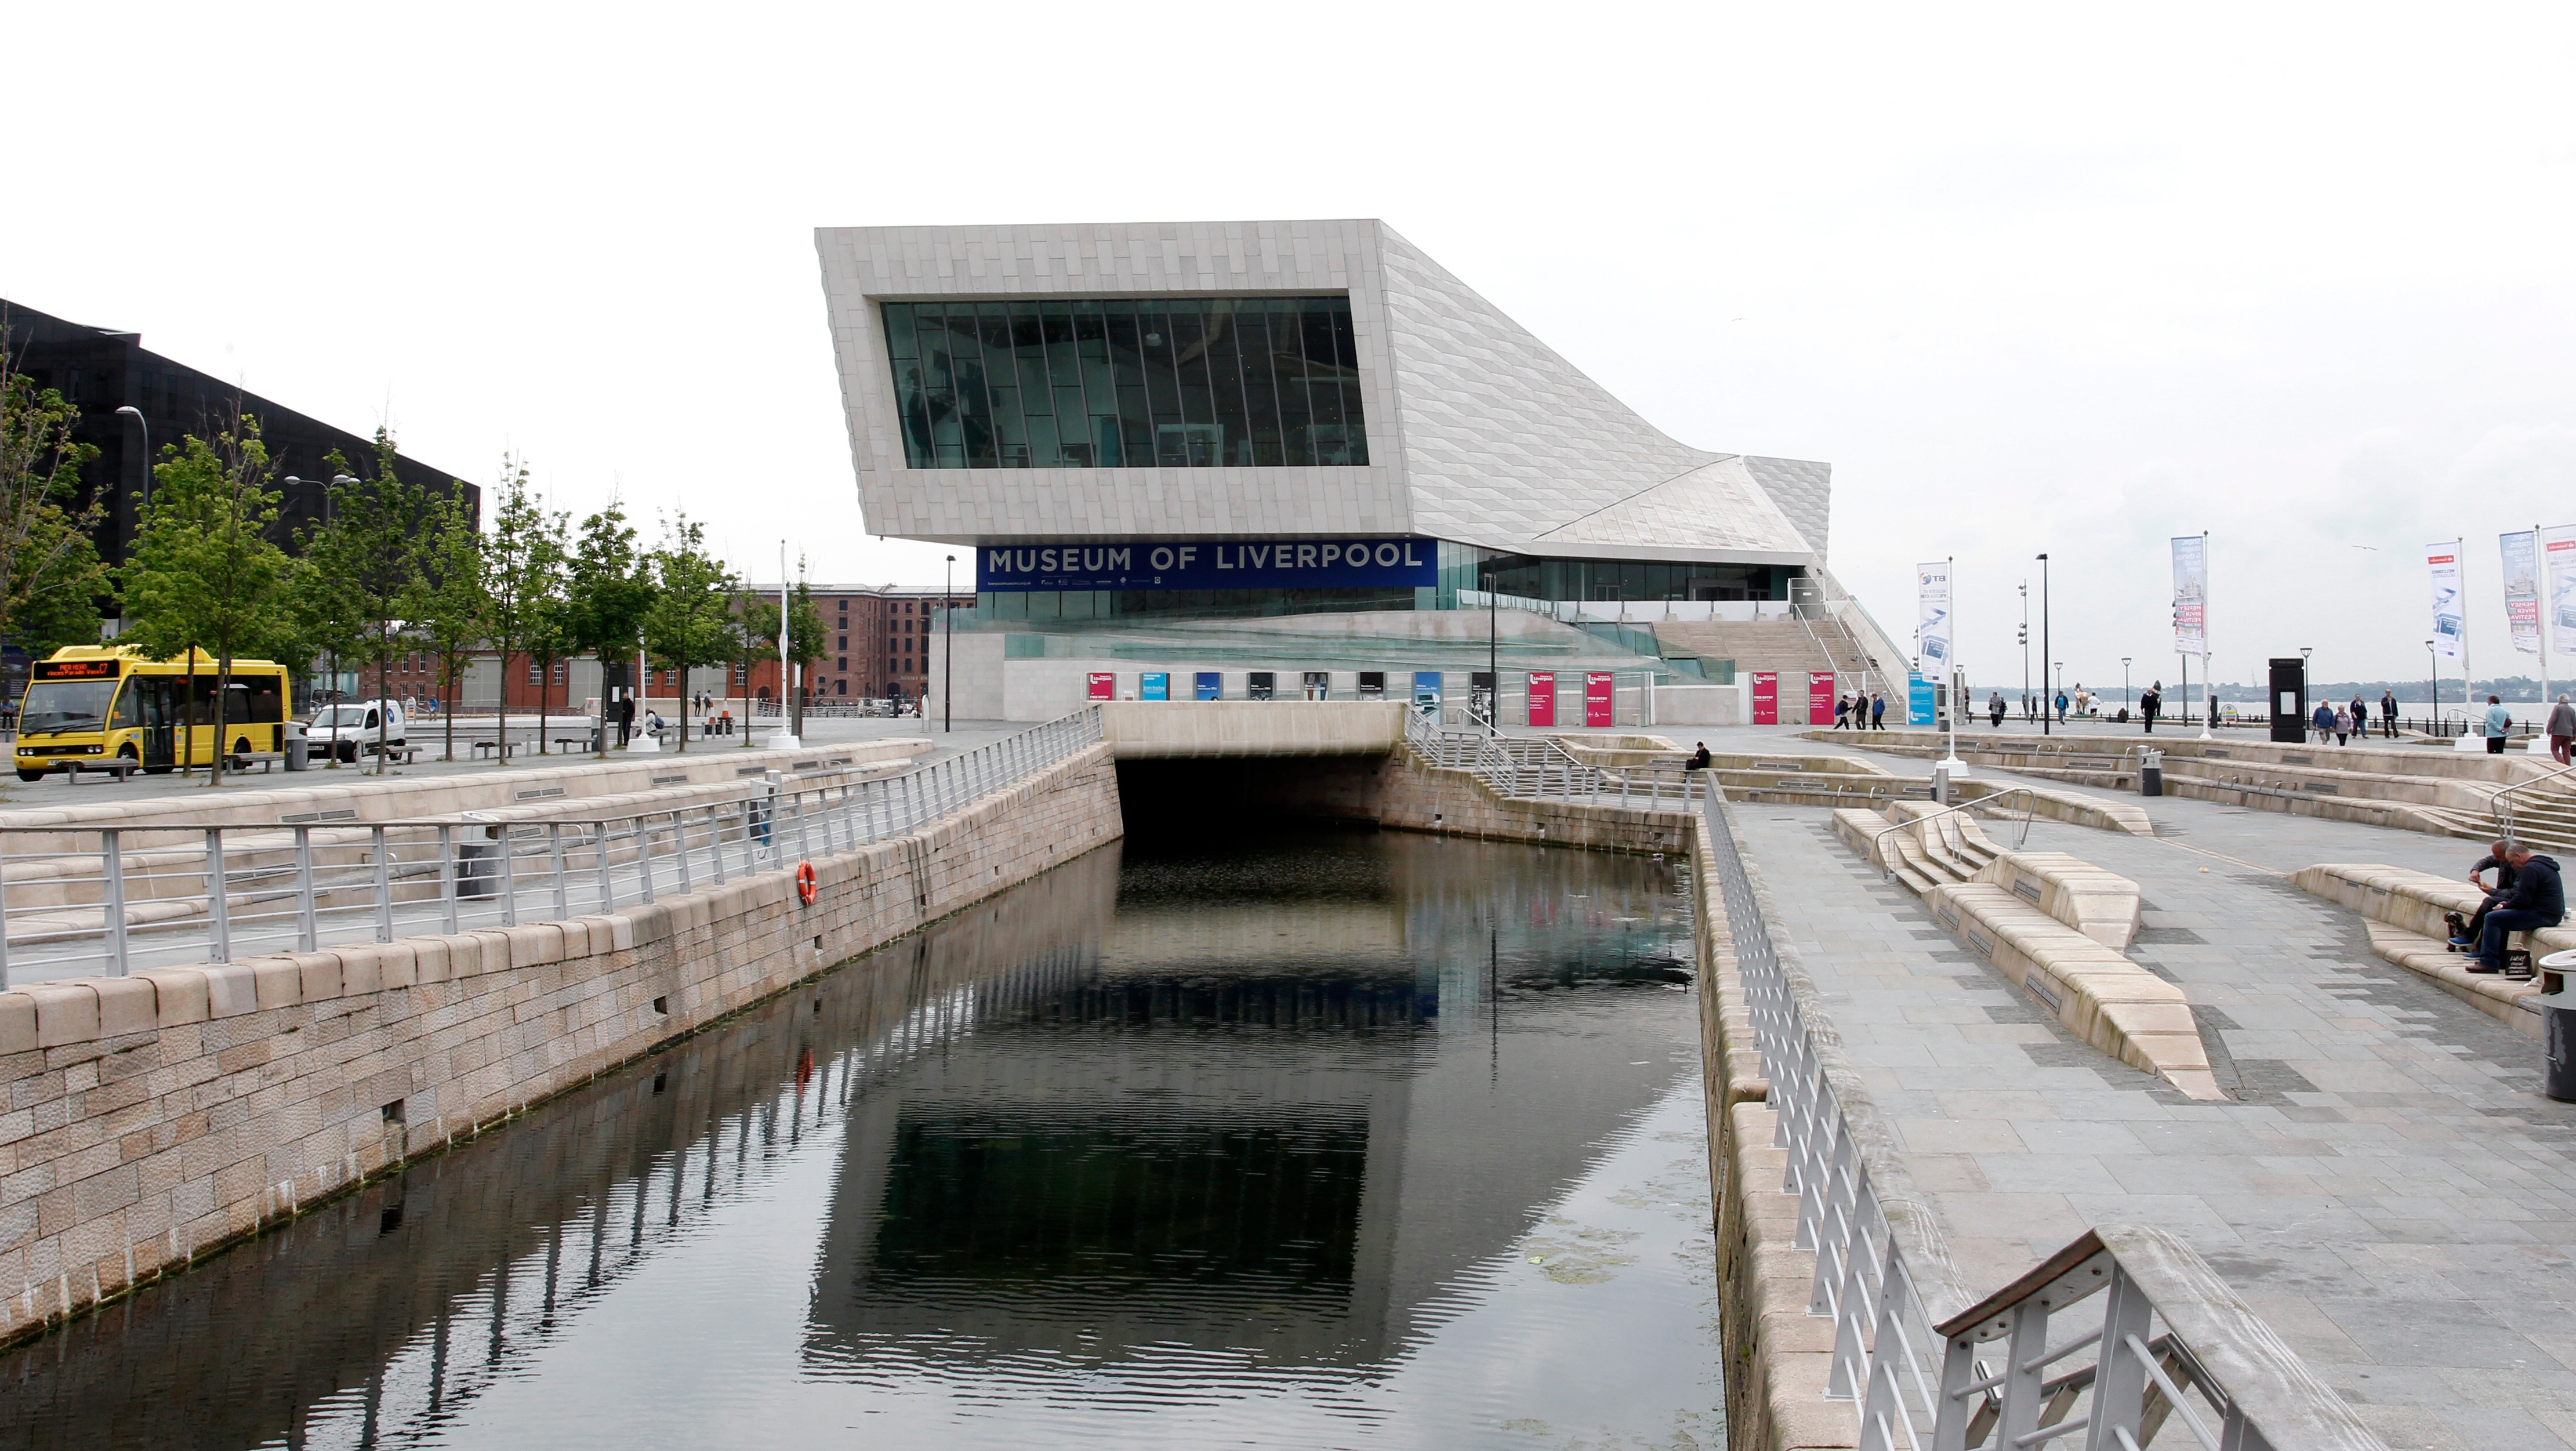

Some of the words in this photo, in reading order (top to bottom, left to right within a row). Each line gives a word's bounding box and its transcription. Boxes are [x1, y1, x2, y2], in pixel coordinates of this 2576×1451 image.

[989, 549, 1130, 572] MUSEUM
[1151, 547, 1195, 569] OF
[1217, 544, 1423, 568] LIVERPOOL
[100, 663, 108, 674] C7
